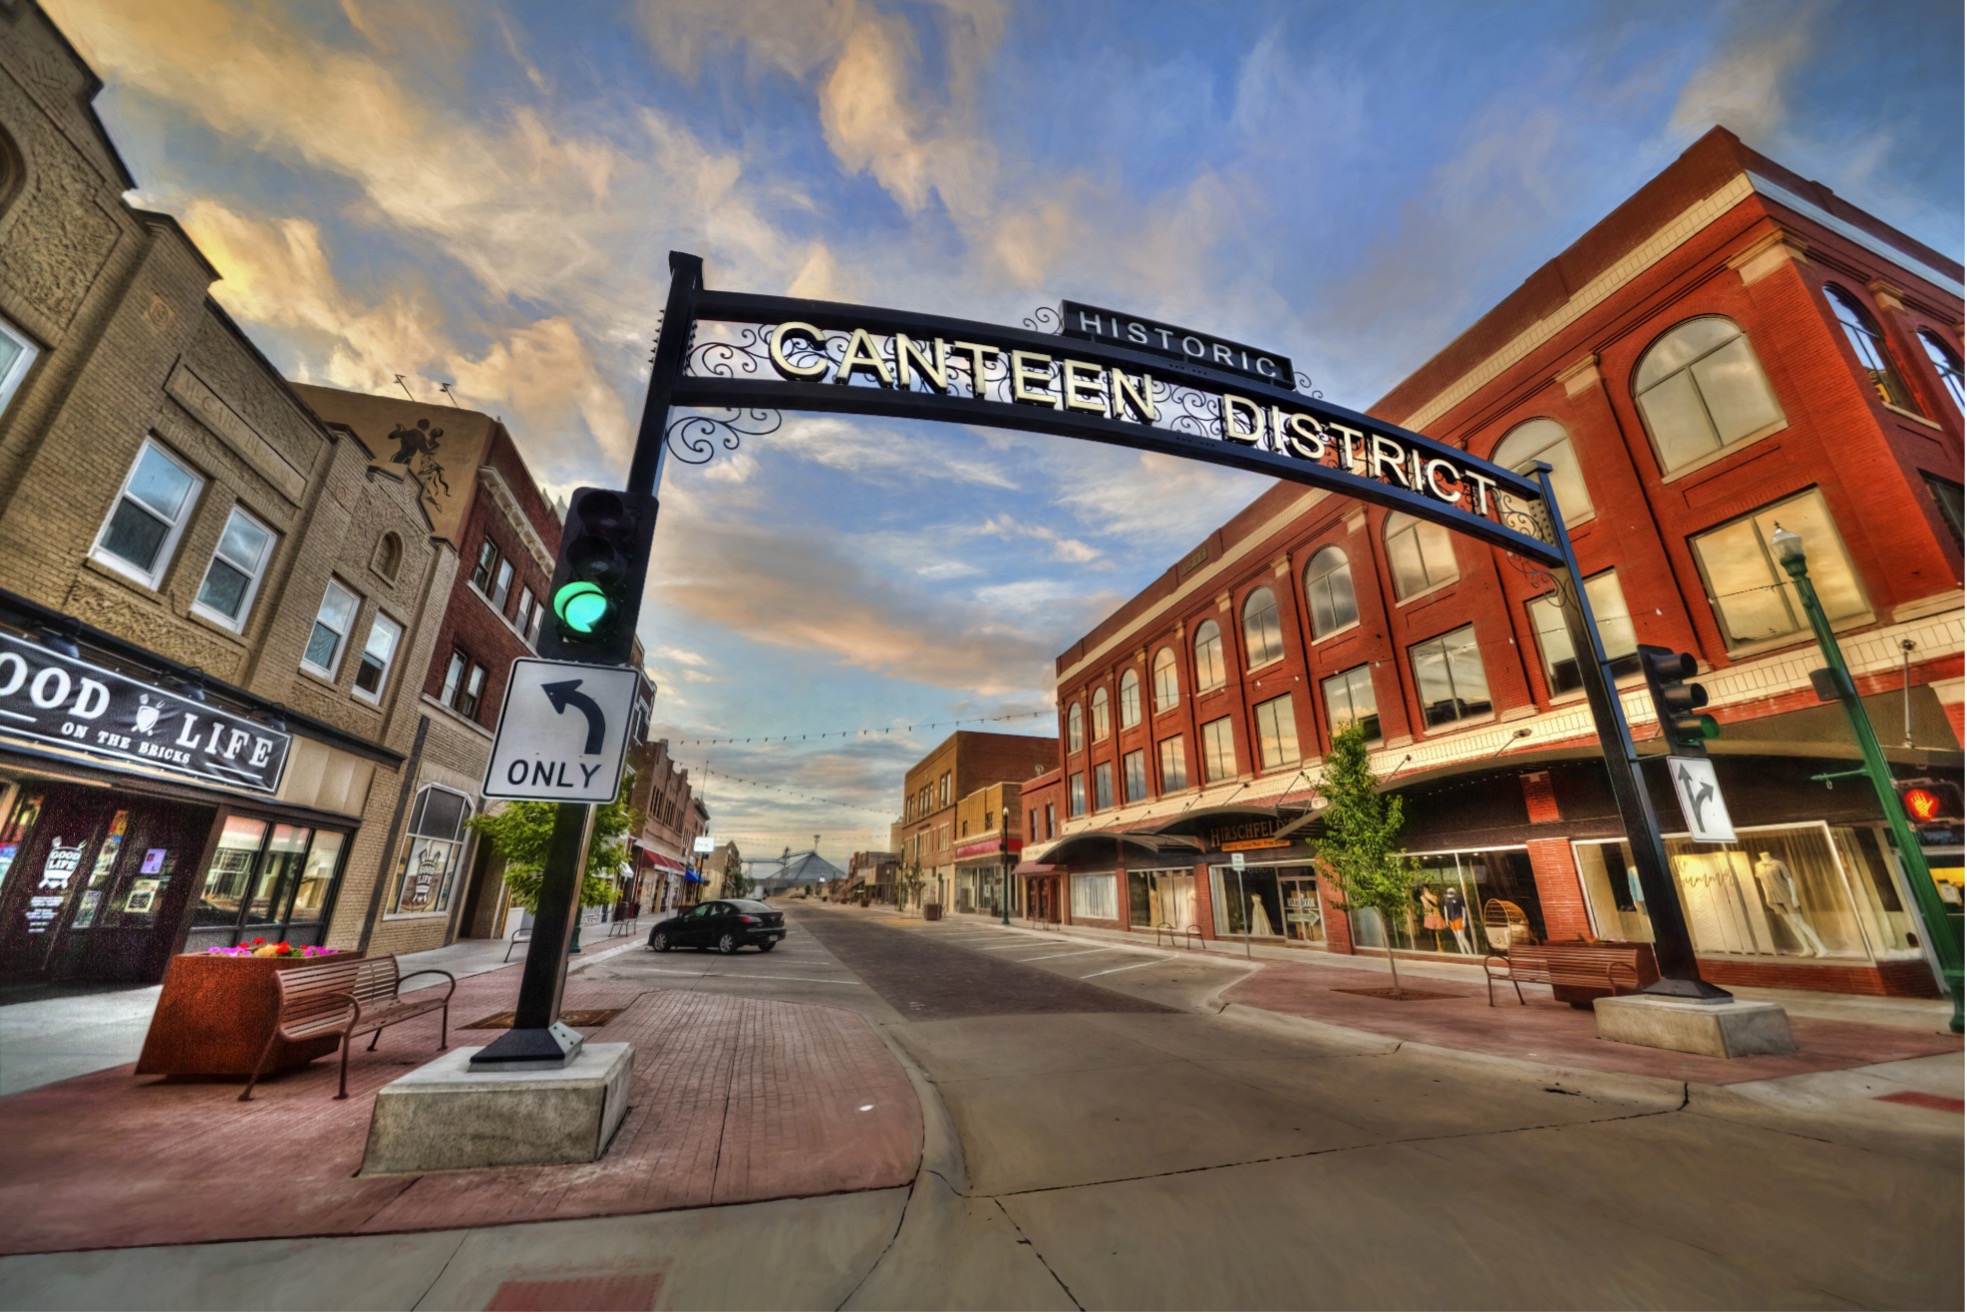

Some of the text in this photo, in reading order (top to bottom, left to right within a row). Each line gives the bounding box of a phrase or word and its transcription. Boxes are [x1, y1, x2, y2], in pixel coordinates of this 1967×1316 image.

[1079, 311, 1276, 378] HISTORIC
[768, 321, 1497, 517] CANTEEN DISTRICT
[61, 721, 191, 765] ON THE BRICKS
[176, 712, 273, 768] LIFE
[507, 759, 602, 789] ONLY
[48, 859, 77, 870] LIFE
[50, 850, 81, 860] GOOD
[419, 865, 435, 875] GOOD
[417, 875, 433, 884] LIFE
